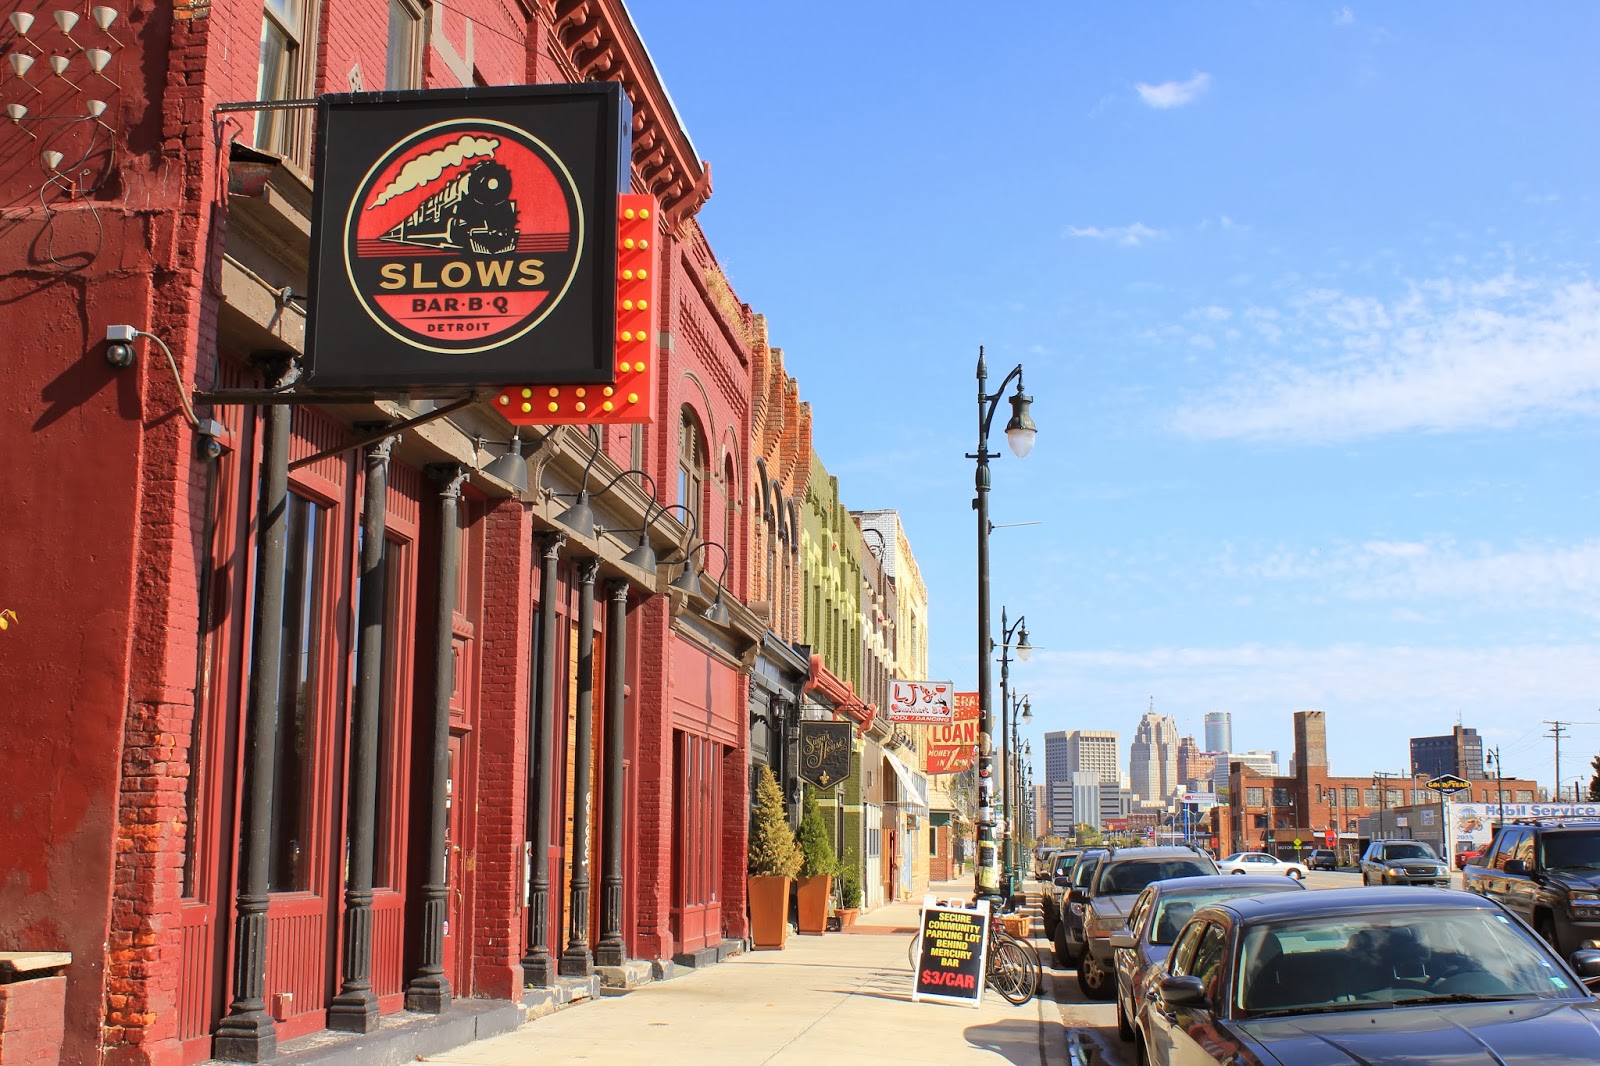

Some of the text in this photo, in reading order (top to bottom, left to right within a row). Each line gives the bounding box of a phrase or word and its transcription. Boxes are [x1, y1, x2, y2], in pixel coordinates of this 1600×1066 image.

[379, 259, 545, 290] SLOWS
[427, 322, 490, 332] DETROIT
[894, 684, 937, 706] LJ's
[807, 737, 847, 768] House
[928, 749, 951, 757] MONEY
[1485, 805, 1596, 816] Mobil Service
[939, 912, 971, 923] SECURE
[928, 921, 980, 934] COMMUNITY
[926, 930, 981, 943] PARKING LOT
[936, 940, 968, 950] BEHIND
[930, 948, 972, 960] MERCURY
[941, 958, 959, 968] BAR
[922, 969, 975, 989] $3/CAR
